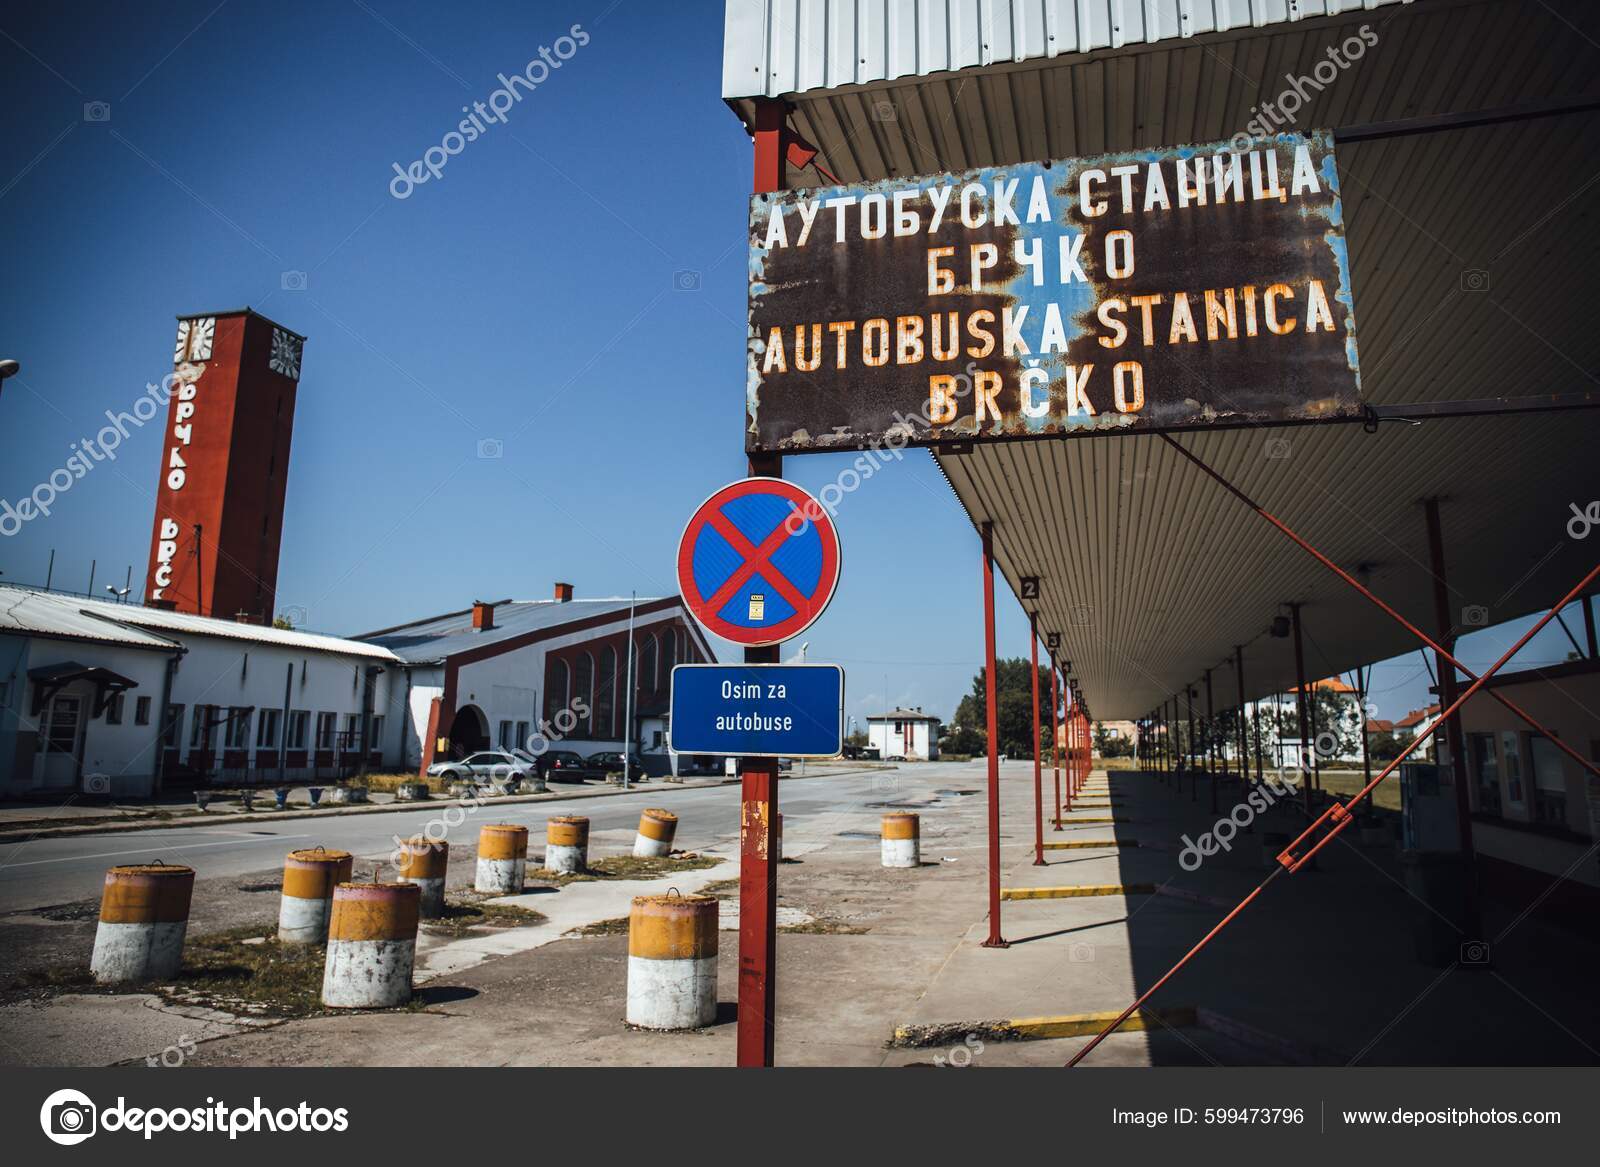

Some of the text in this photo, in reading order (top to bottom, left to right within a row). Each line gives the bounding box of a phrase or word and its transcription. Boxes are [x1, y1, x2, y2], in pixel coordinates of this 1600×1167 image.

[764, 144, 1322, 250] АУТОБУСКА СТАНИЦА
[926, 229, 1137, 295] БРЧКО
[762, 280, 1336, 374] AUTOBUSKA STANICA
[929, 358, 1145, 425] BRČKO
[1024, 582, 1035, 596] 2
[715, 712, 792, 731] autobuse
[722, 680, 786, 699] Osim za
